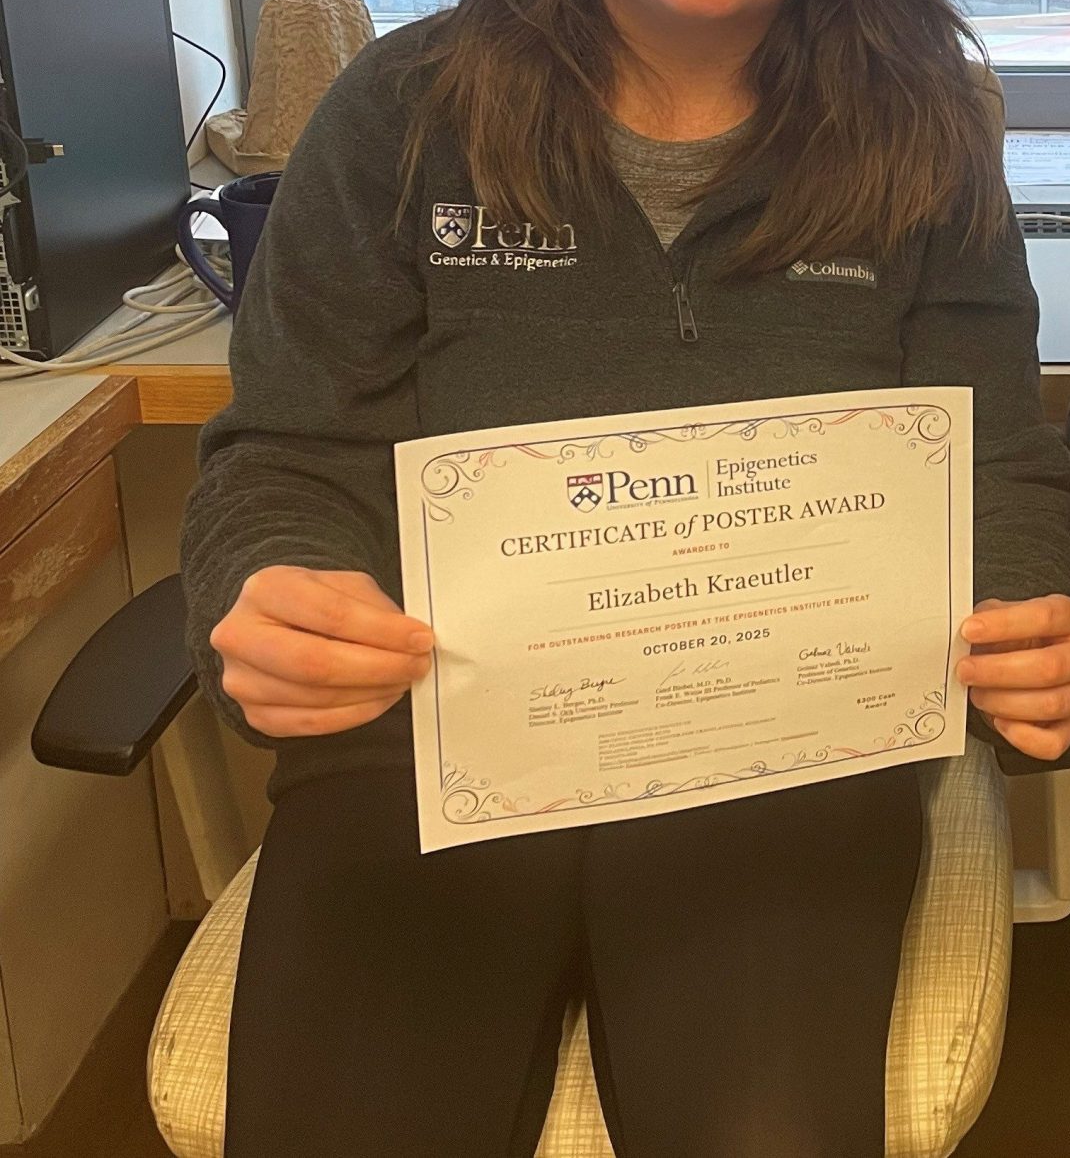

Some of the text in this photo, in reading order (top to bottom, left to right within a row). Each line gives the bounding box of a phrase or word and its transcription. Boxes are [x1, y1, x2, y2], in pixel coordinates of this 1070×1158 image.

[429, 252, 487, 267] Genetics
[490, 253, 501, 266] &
[809, 262, 875, 282] Columbia
[716, 451, 818, 480] Epigenetics
[606, 470, 698, 504] Penn
[717, 476, 791, 498] Institute
[501, 492, 886, 557] CERTIFICATE of POSTER AWARD
[672, 542, 730, 557] AWARDED TO
[588, 563, 814, 612] Elizabeth Kraeutler
[527, 593, 870, 652] FOR OUTSTANDING RESEARCH POSTER AT THE EPIGENETICS INSTITUTE RETREAT
[643, 627, 771, 656] OCTOBER 20, 2025
[864, 701, 888, 710] Award
